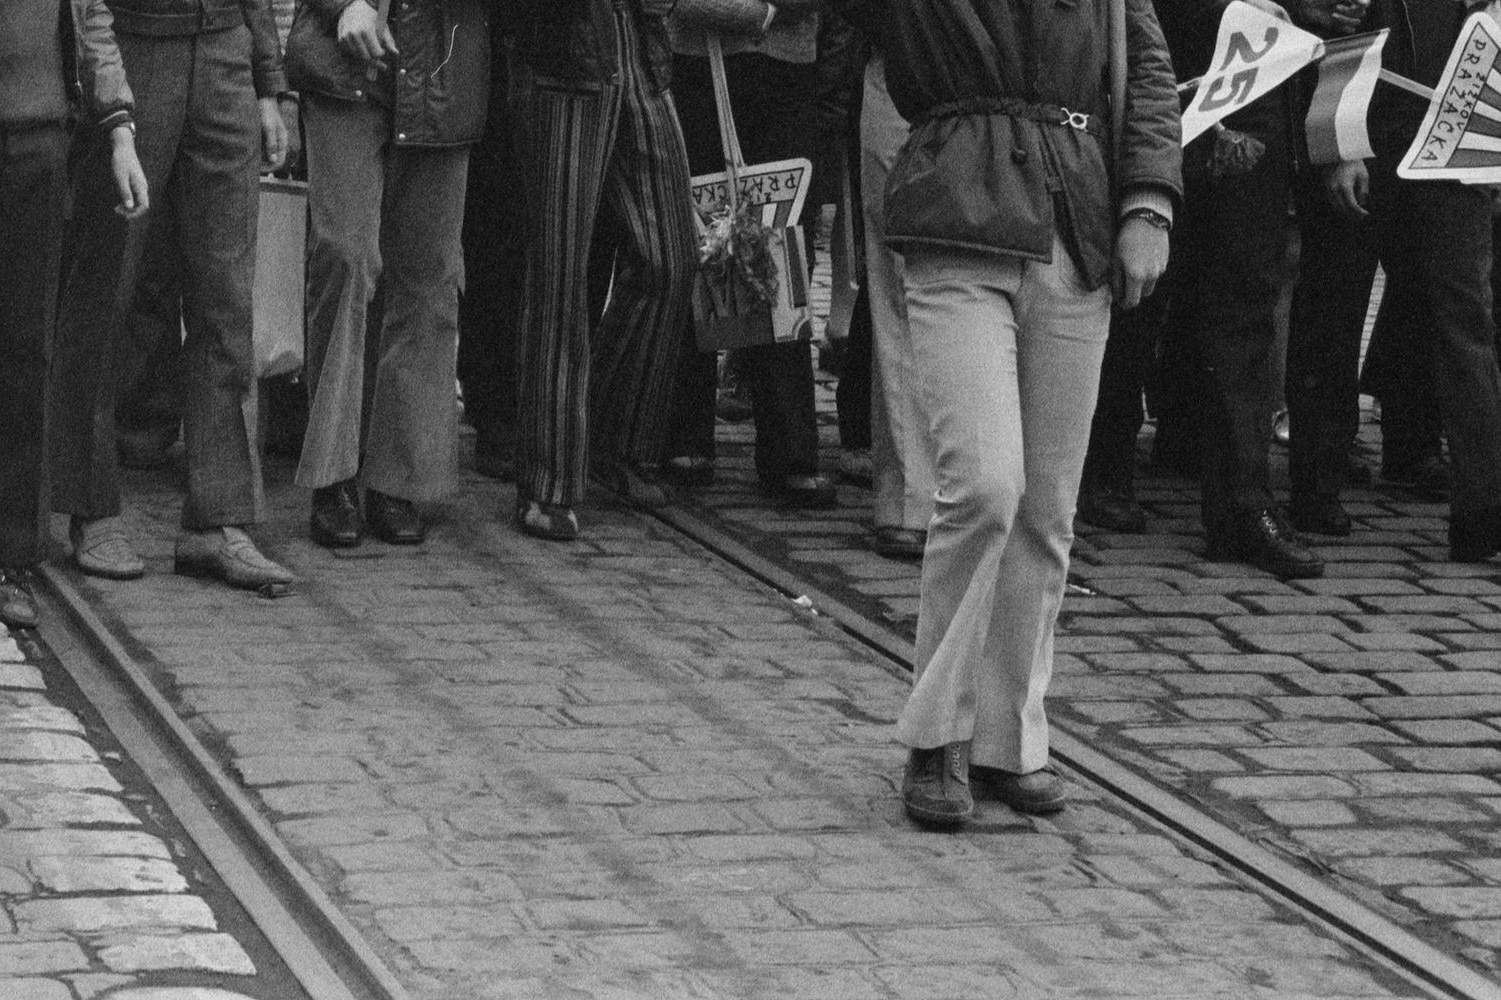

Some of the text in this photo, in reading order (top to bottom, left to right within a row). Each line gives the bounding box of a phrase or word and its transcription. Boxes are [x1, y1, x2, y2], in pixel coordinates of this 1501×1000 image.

[1198, 27, 1279, 112] 25
[1421, 39, 1486, 162] PRAŽAČKA
[1456, 71, 1487, 131] ŽIŽKOV
